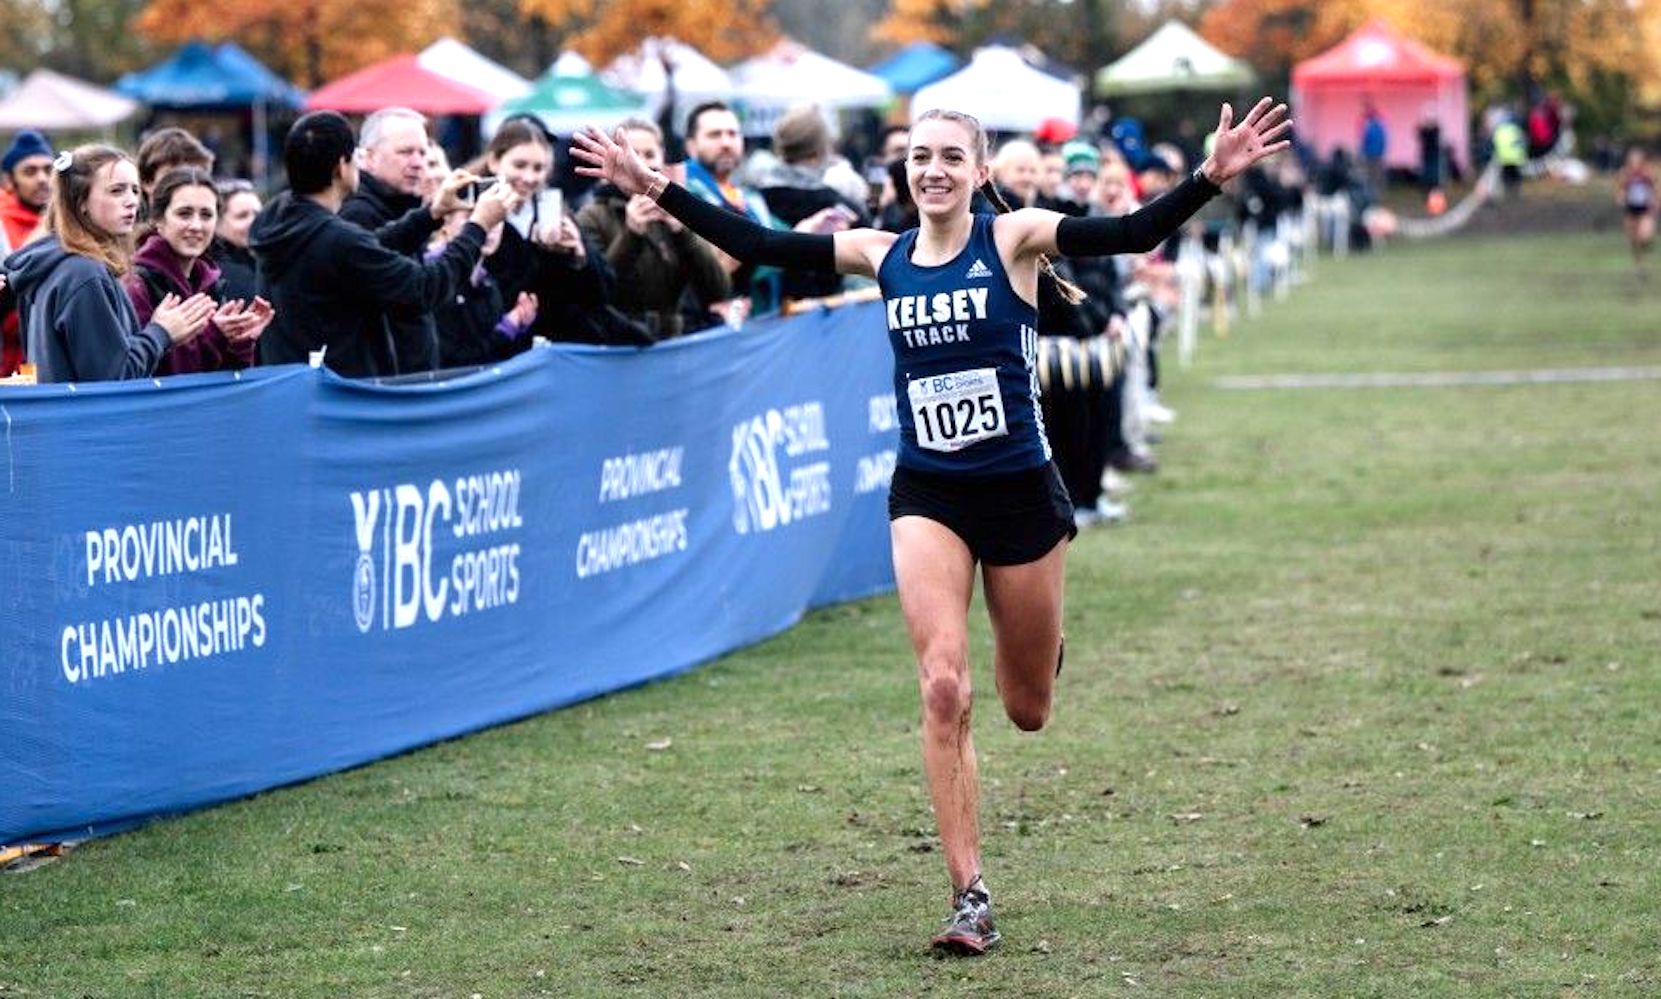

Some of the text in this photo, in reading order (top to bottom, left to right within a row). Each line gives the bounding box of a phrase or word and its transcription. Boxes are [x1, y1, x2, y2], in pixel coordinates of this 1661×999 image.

[886, 287, 989, 331] KELSEY
[902, 323, 971, 349] TRACK
[918, 394, 1000, 442] 1025
[932, 376, 954, 393] BC
[453, 468, 523, 538] SCHOOL
[599, 445, 685, 503] PROVINCIAL
[746, 408, 792, 530] BC
[86, 513, 238, 586] PROVINCIAL
[394, 479, 452, 629] BC
[576, 507, 689, 579] CHAMPIONSHIPS
[450, 543, 520, 616] SPORTS
[61, 594, 266, 683] CHAMPIONSHIPS
